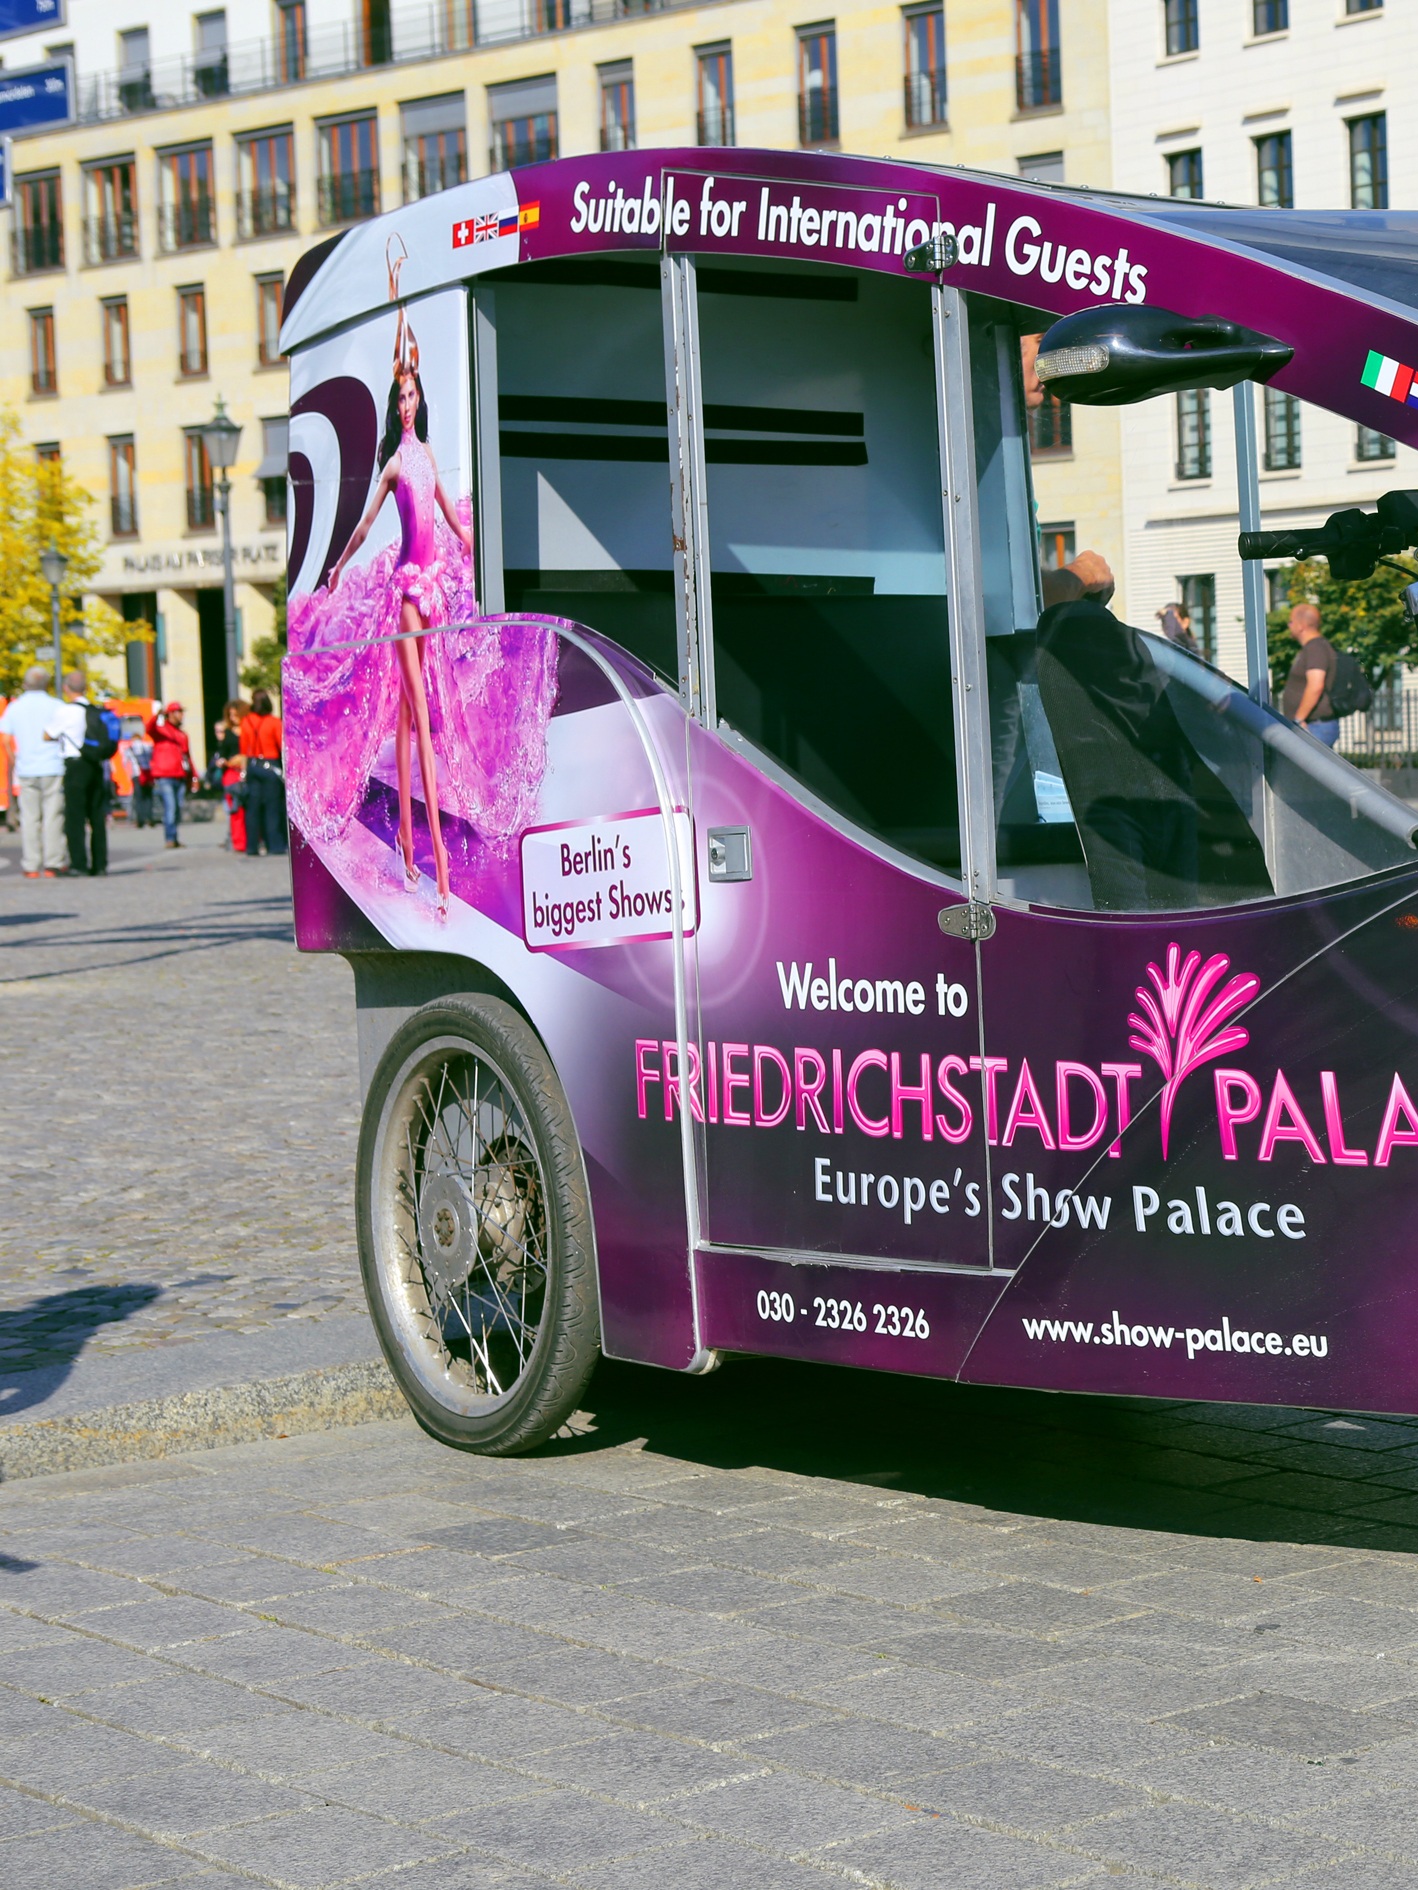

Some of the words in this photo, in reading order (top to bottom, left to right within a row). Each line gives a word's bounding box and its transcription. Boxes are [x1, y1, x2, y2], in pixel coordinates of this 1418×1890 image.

[570, 176, 690, 235] Suitable
[700, 176, 747, 237] for
[1005, 215, 1148, 304] Guests
[560, 834, 631, 877] Berlin's
[533, 891, 602, 937] biggest
[608, 880, 685, 920] Shows
[775, 957, 926, 1016] Welcome
[936, 973, 969, 1018] to
[635, 1038, 1142, 1159] FRIEDRICHSTADT
[814, 1157, 981, 1226] Europe's
[1001, 1172, 1112, 1230] Show
[1132, 1185, 1307, 1240] Palace
[756, 1289, 794, 1323] 030
[813, 1296, 867, 1332] 2326
[873, 1303, 930, 1340] 2326
[1021, 1310, 1329, 1359] www.show-palace.eu
